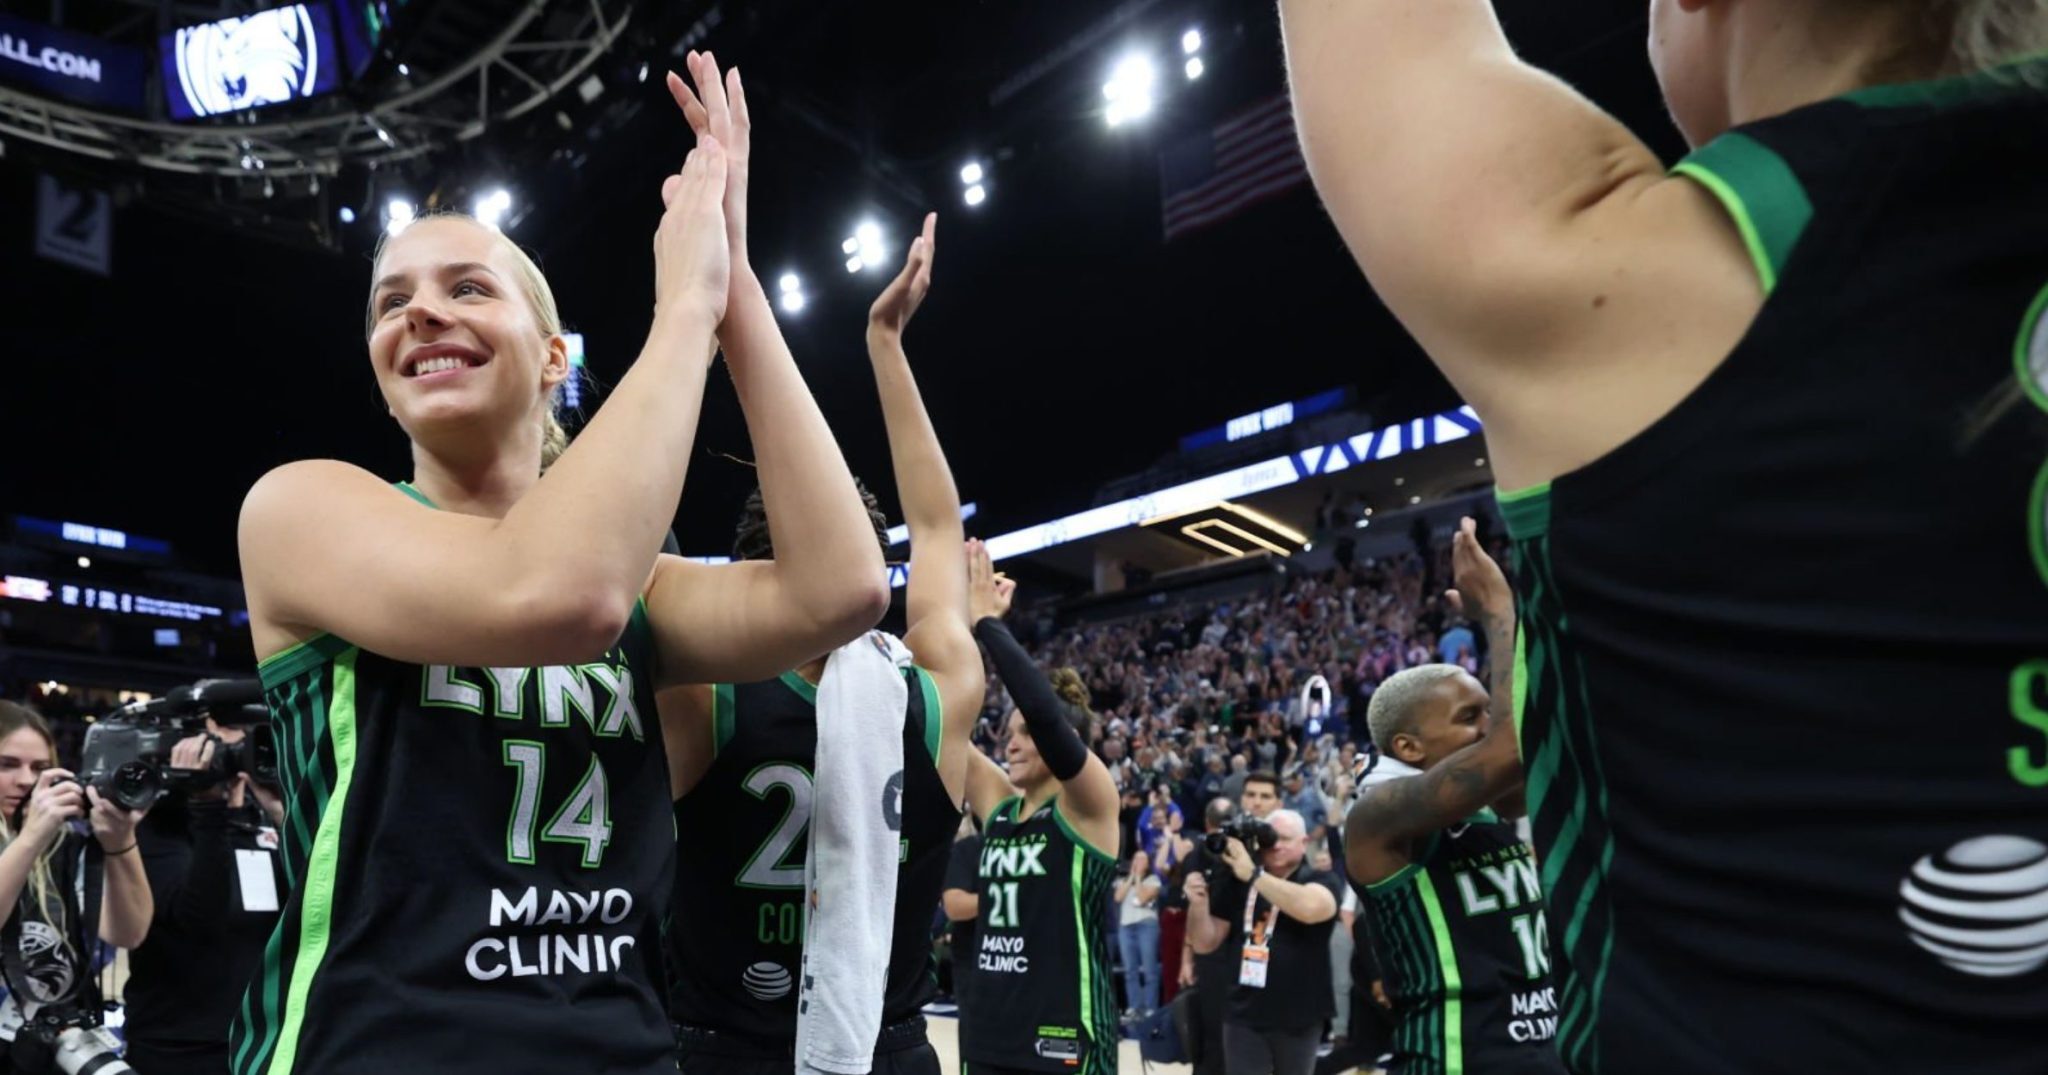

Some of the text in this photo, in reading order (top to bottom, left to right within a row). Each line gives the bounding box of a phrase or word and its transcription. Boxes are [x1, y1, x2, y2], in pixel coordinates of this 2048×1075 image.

[0, 34, 101, 82] LL.COM
[502, 739, 613, 868] 14
[489, 886, 633, 926] MAYO
[988, 882, 1020, 927] 21
[1455, 855, 1542, 917] LYN
[979, 953, 1028, 973] CLINIC
[982, 934, 1024, 953] MAYO
[1508, 1015, 1558, 1043] CLIN
